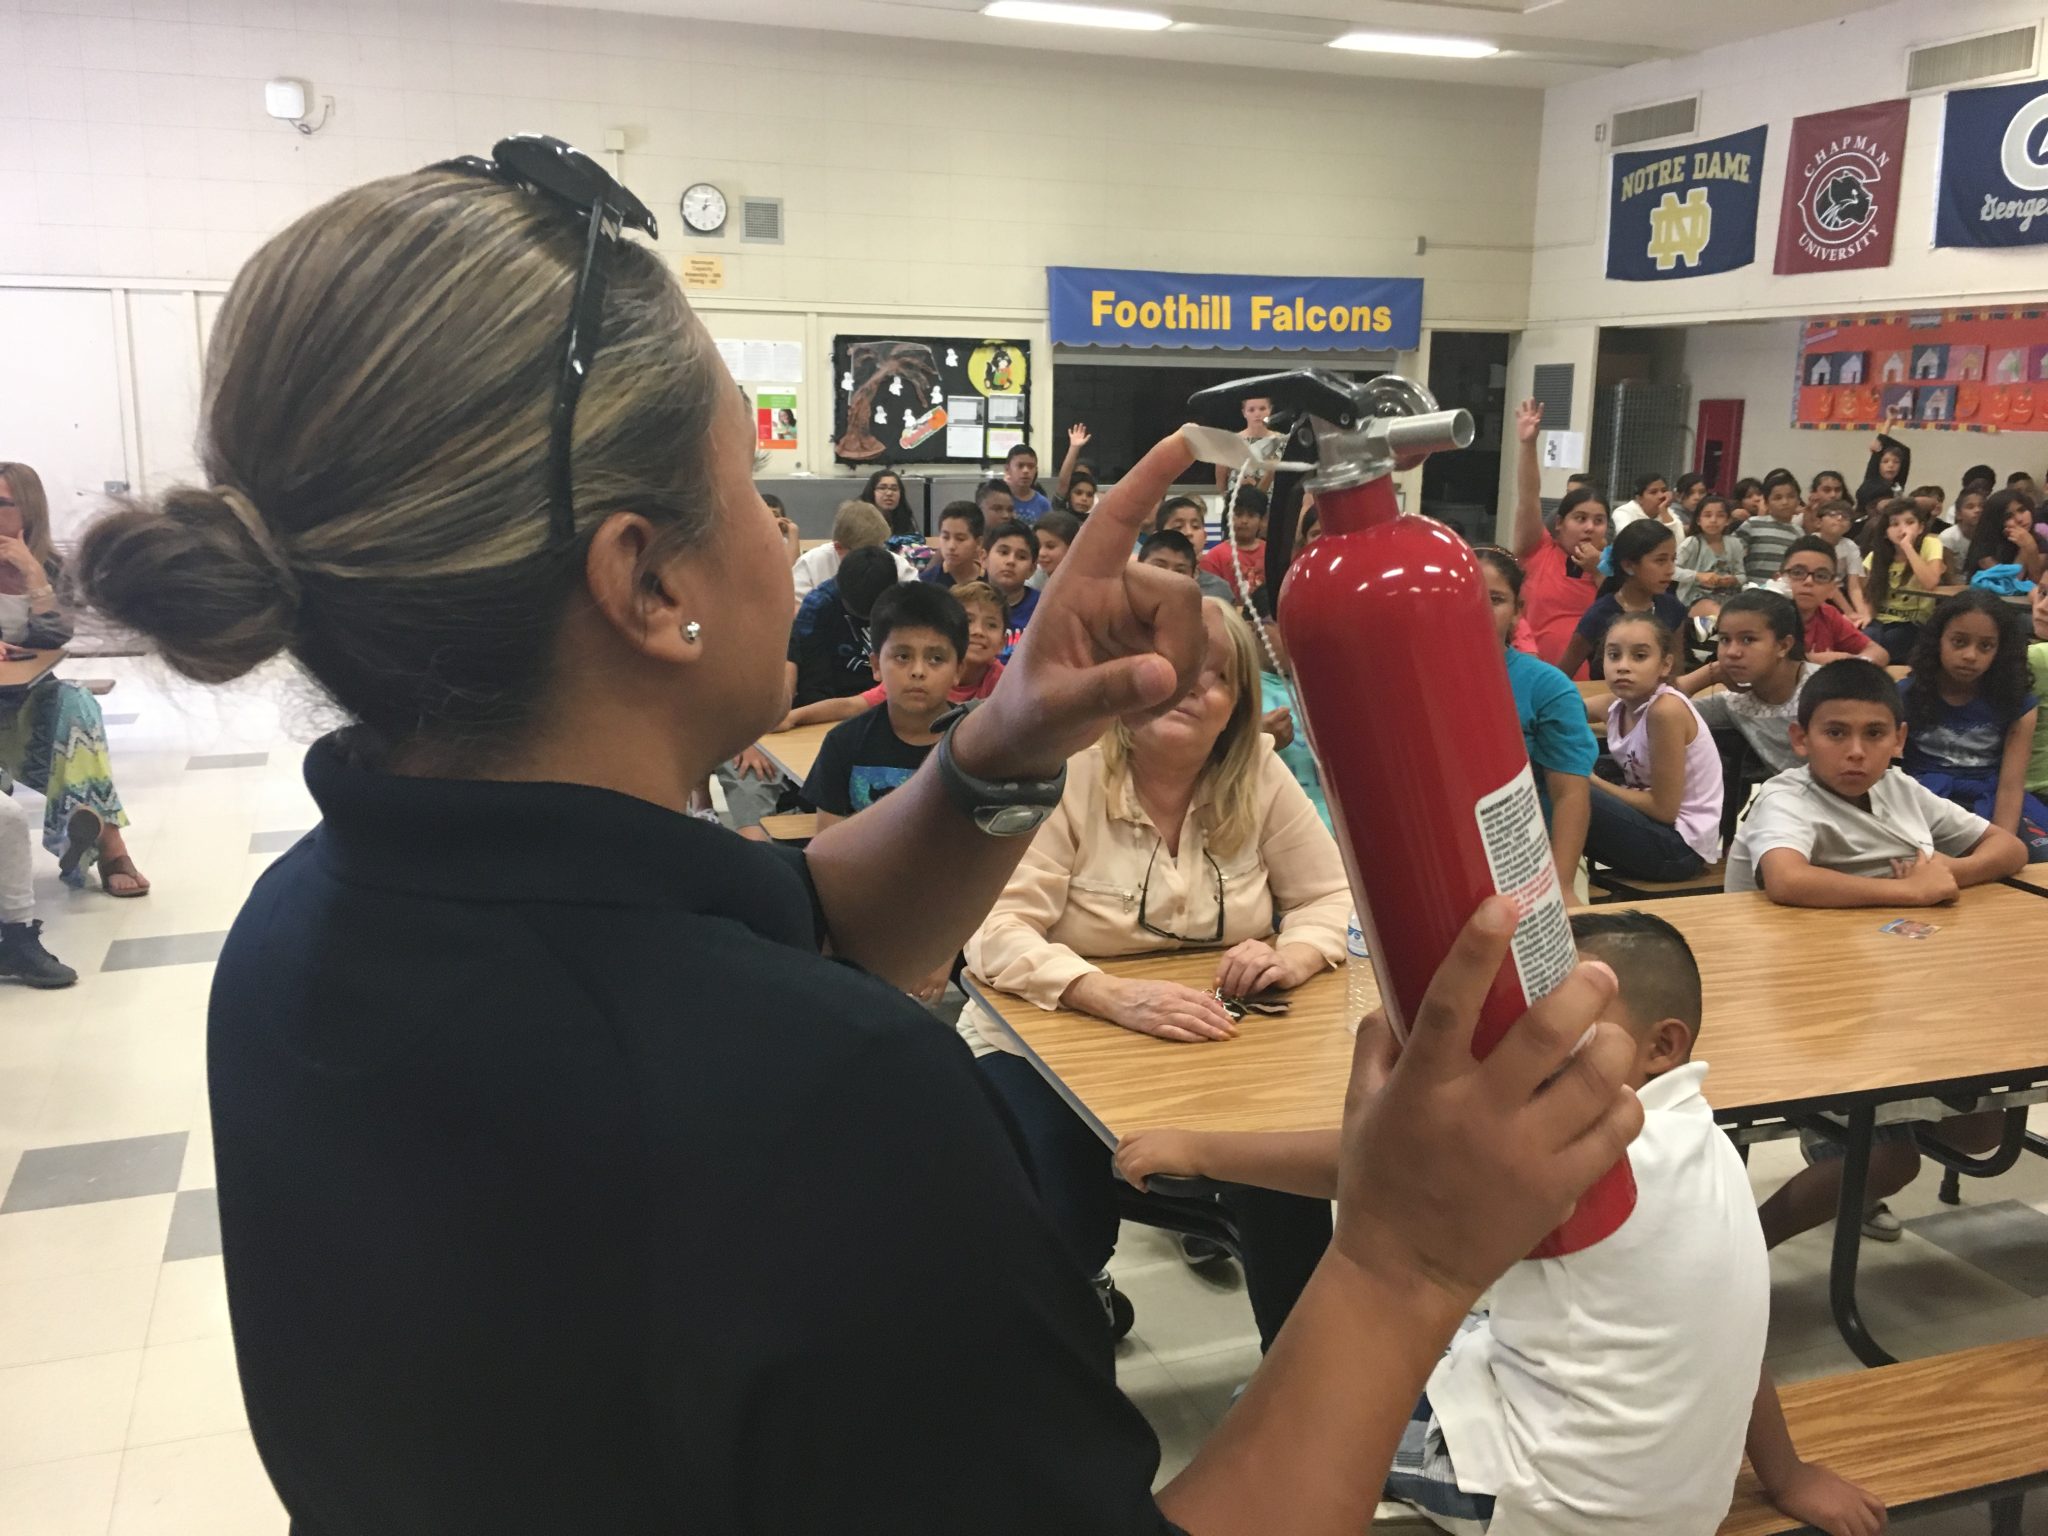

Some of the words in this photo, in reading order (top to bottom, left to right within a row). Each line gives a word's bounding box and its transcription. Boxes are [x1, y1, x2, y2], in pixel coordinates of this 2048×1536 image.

[1621, 155, 1686, 202] NOTRE
[1692, 151, 1751, 183] DAME
[1804, 135, 1890, 178] CHAPMAN
[1980, 193, 2048, 232] George
[1798, 224, 1880, 261] UNIVERSITY
[1091, 290, 1231, 330] Foothill
[1251, 296, 1392, 332] Falcons
